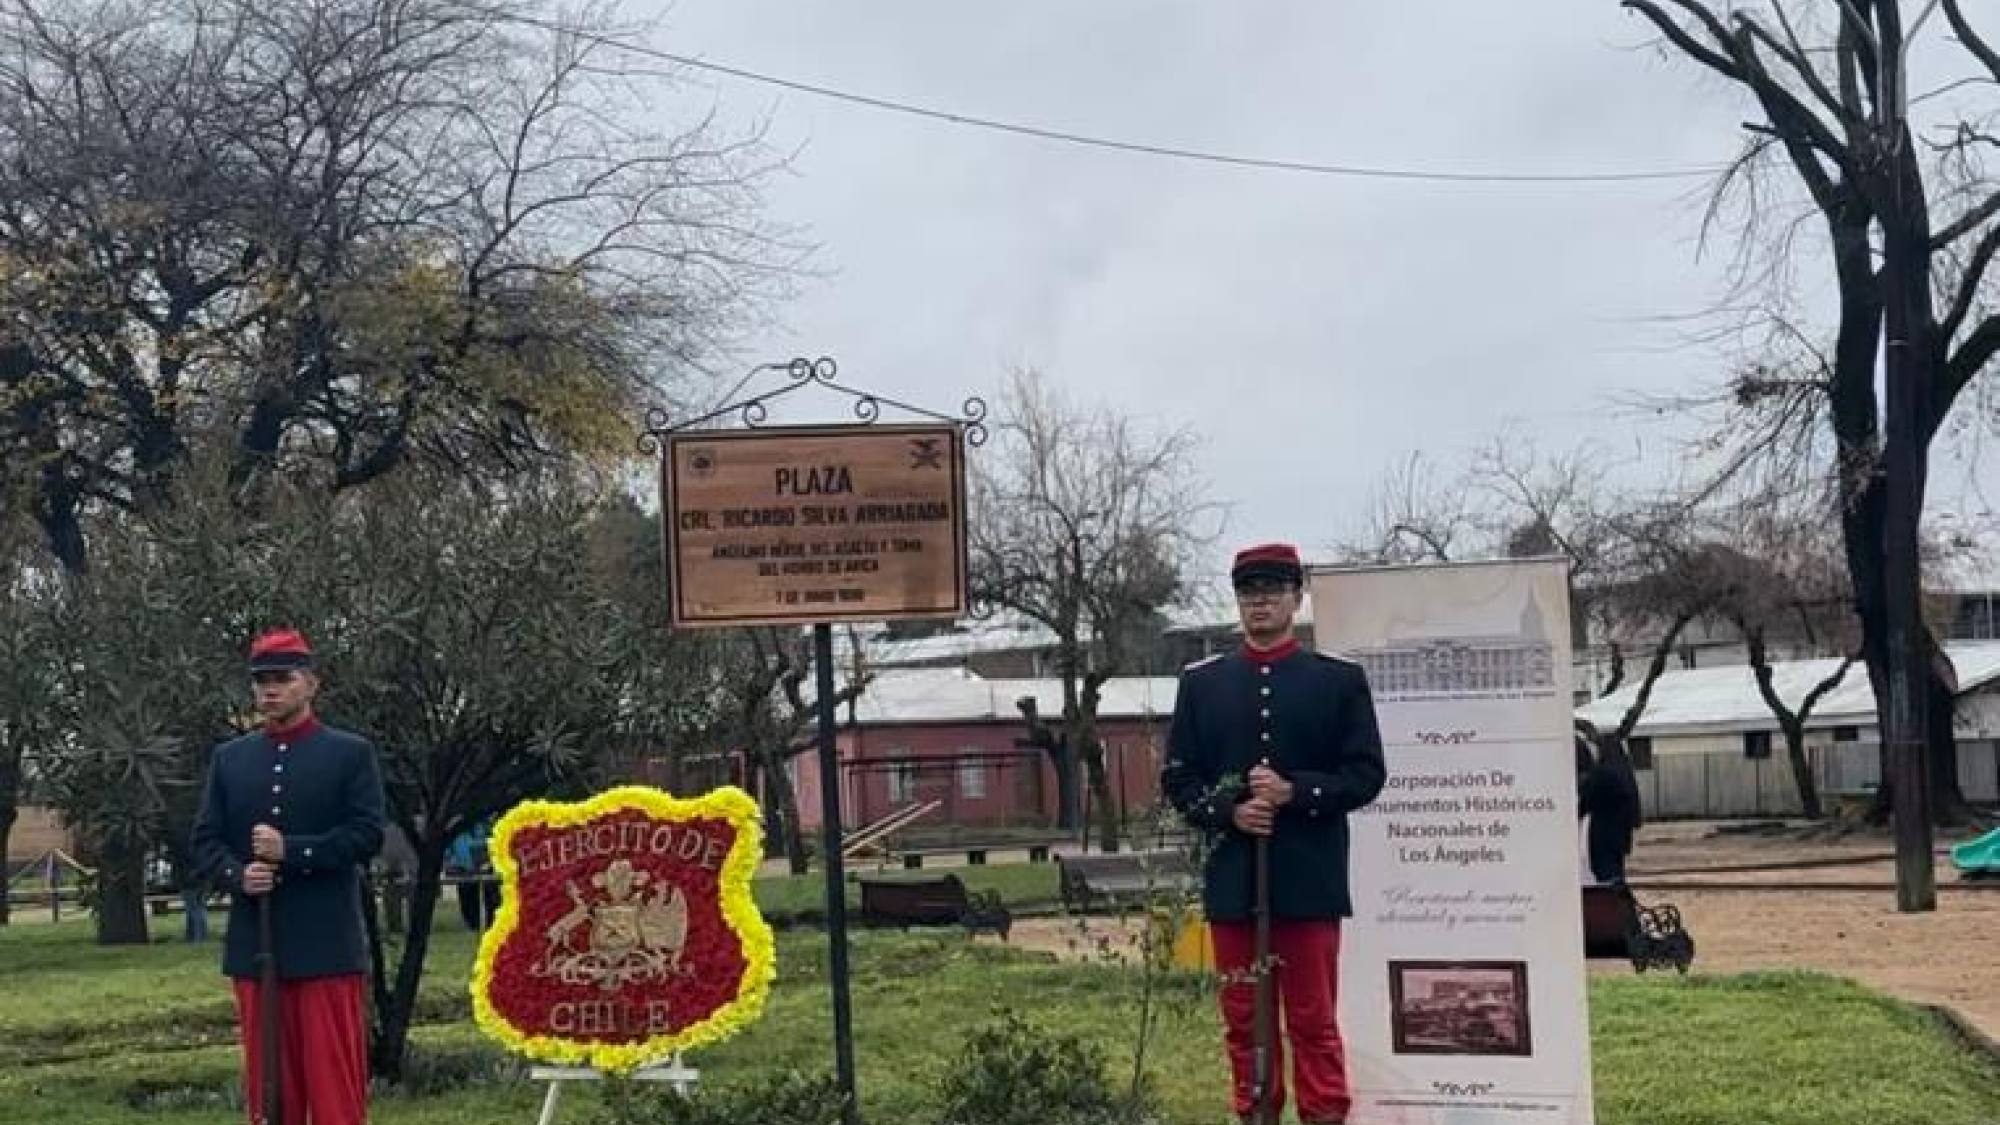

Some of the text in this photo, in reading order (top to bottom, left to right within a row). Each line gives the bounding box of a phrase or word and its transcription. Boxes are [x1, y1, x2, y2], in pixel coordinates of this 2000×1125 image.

[776, 465, 852, 495] PLAZA
[723, 507, 795, 528] RICARDO
[801, 504, 848, 526] SILVA
[855, 501, 949, 523] ARRIAGADA
[1388, 770, 1516, 791] orporación De
[1465, 794, 1556, 812] Históricos
[1387, 820, 1511, 838] Nacionales de
[519, 821, 722, 876] EJERCITO DE
[1400, 847, 1430, 863] Los
[552, 1002, 669, 1033] CHILE
